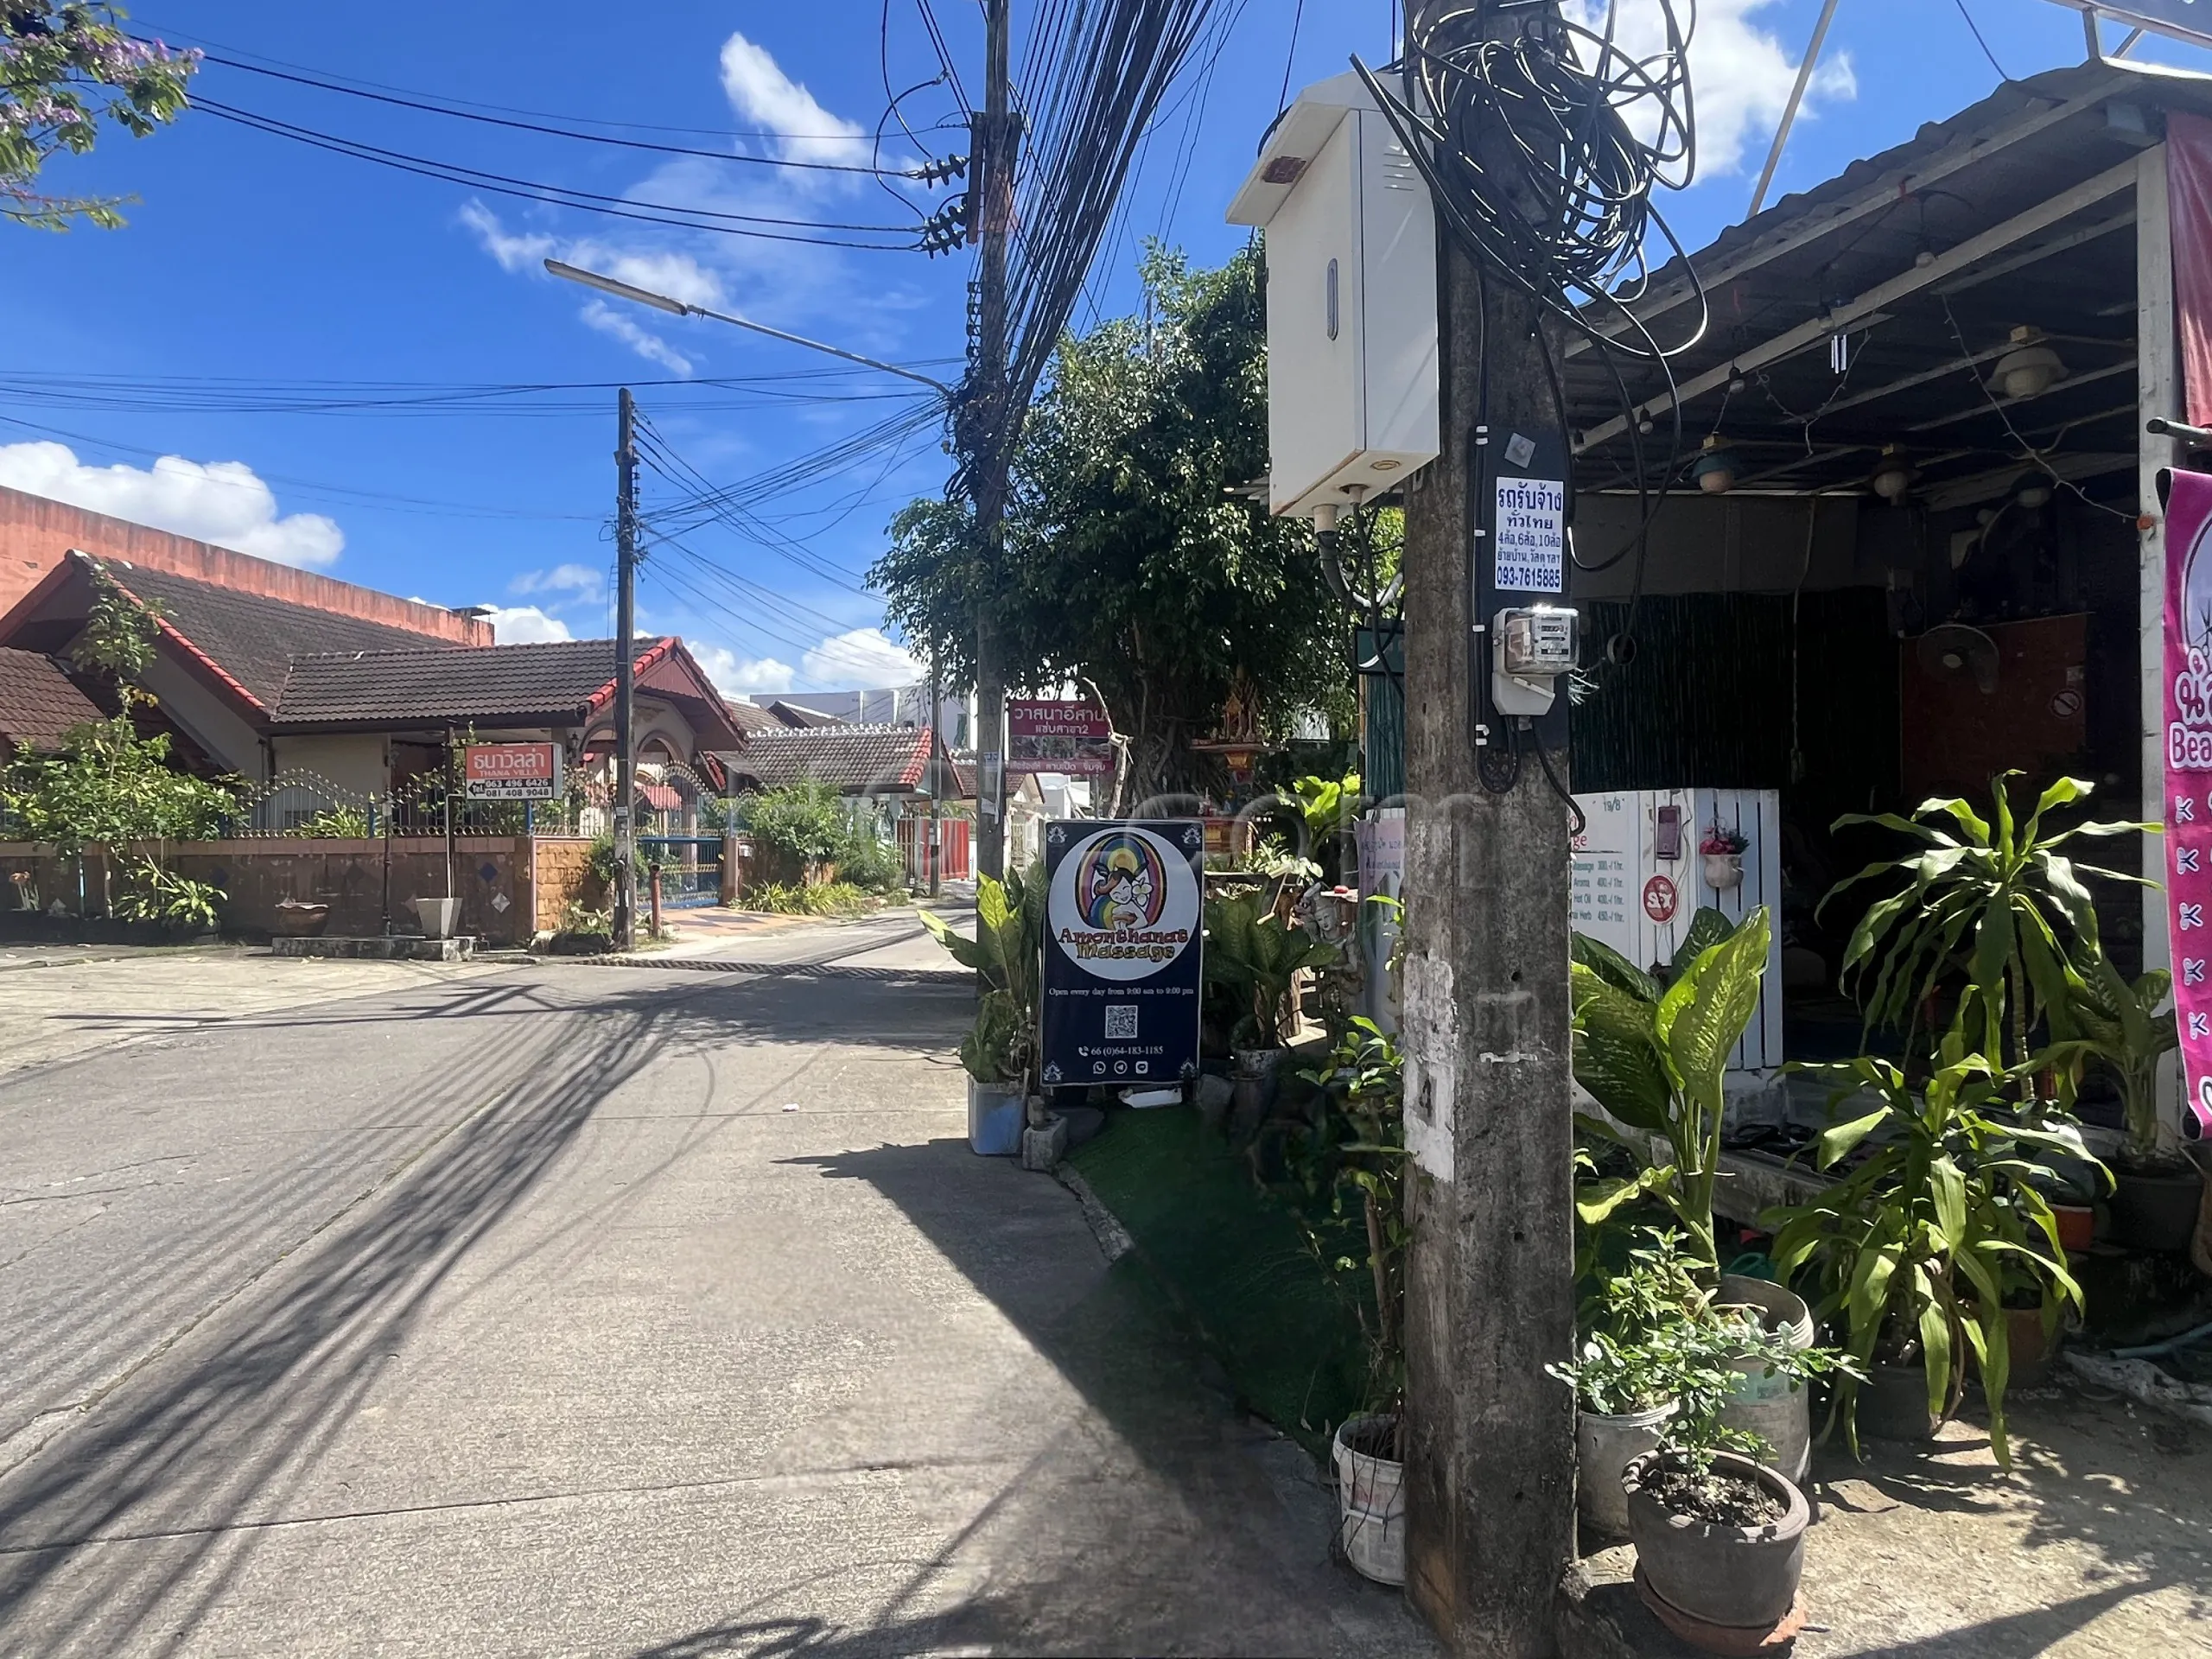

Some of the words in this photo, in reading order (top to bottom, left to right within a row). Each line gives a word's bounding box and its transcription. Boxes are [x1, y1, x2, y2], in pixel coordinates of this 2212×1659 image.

[1498, 481, 1561, 511] รถรับจ้าง
[1507, 510, 1553, 529] ทั่วไทย
[1497, 566, 1560, 588] 093-7615885
[1014, 704, 1105, 721] วาสนาอีสาน
[474, 747, 544, 769] ธนาวิลล่า
[1058, 928, 1188, 944] Amonthanat
[1076, 944, 1175, 963] Massage
[1092, 988, 1105, 996] day
